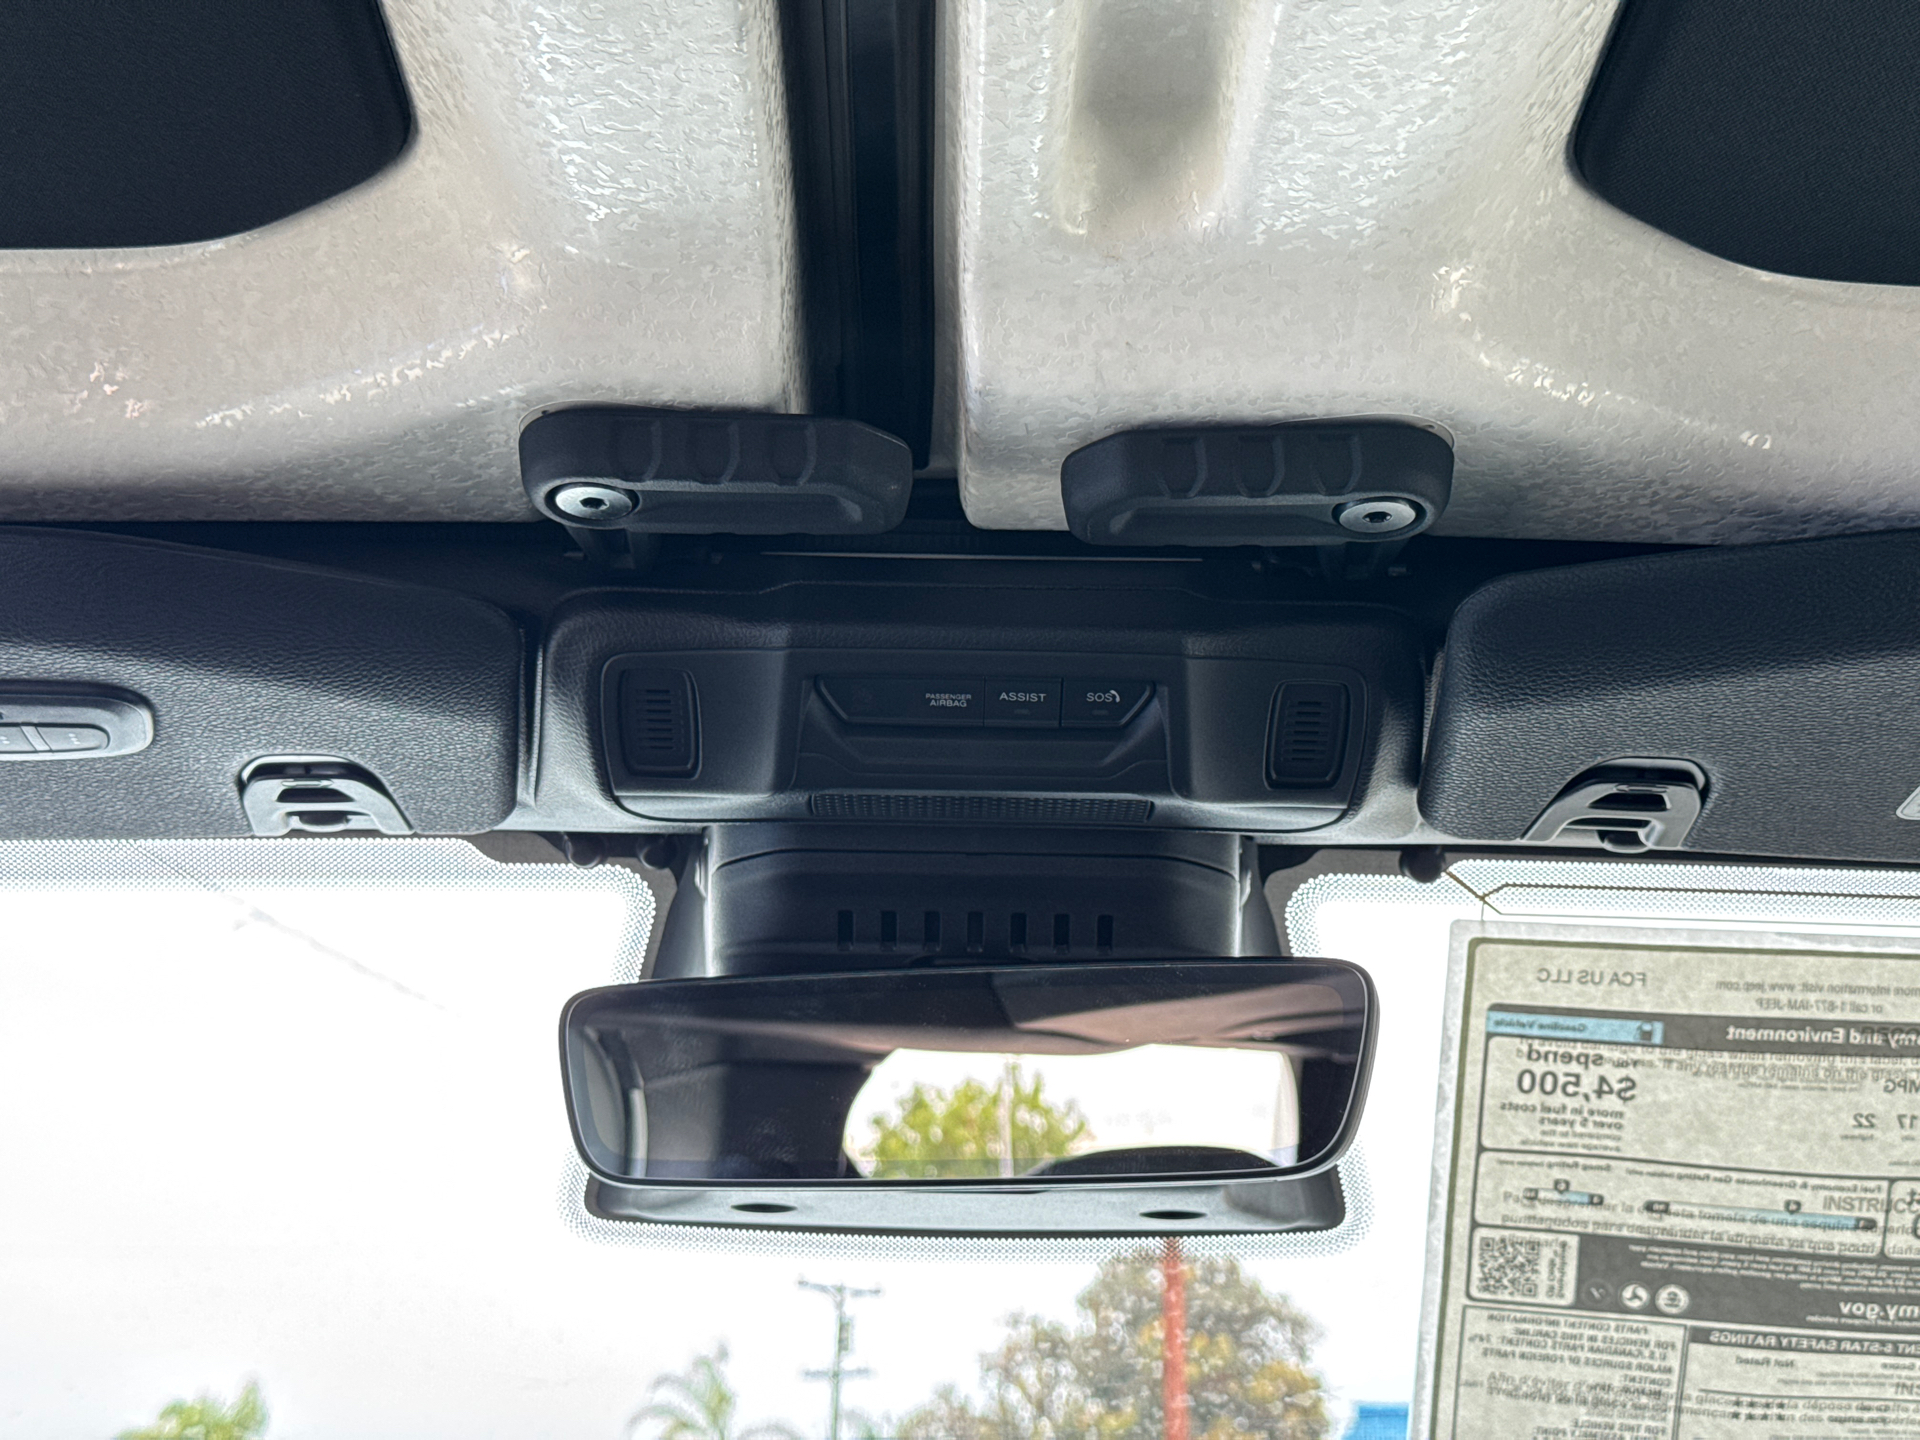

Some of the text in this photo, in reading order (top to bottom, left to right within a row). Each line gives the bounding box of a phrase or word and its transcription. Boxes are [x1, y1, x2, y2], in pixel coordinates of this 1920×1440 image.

[999, 692, 1046, 702] ASSIST
[1086, 692, 1112, 702] SOS
[930, 698, 967, 708] AIRBAG
